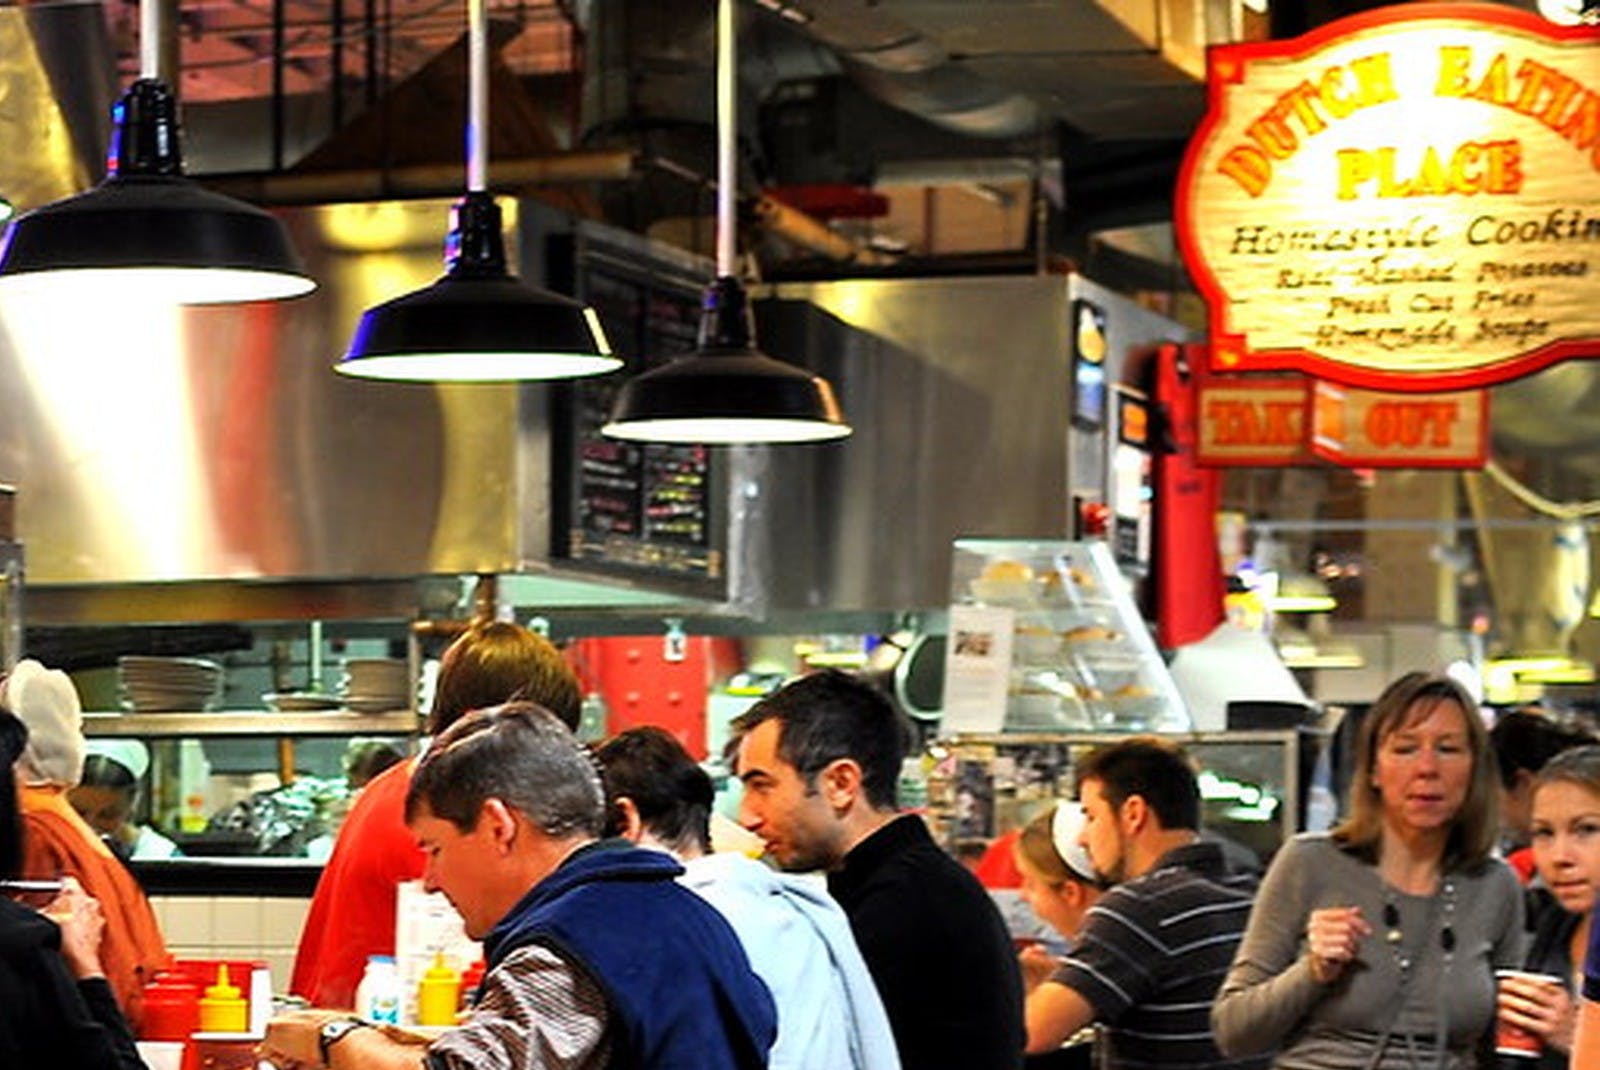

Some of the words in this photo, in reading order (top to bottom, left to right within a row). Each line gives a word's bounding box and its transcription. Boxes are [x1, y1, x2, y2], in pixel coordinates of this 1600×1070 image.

[1216, 52, 1398, 198] DUTCH
[1434, 46, 1600, 174] EATIN
[1336, 139, 1524, 200] PLACE
[1467, 207, 1600, 247] Cookin
[1208, 400, 1304, 445] TAK
[1365, 401, 1459, 448] OUT
